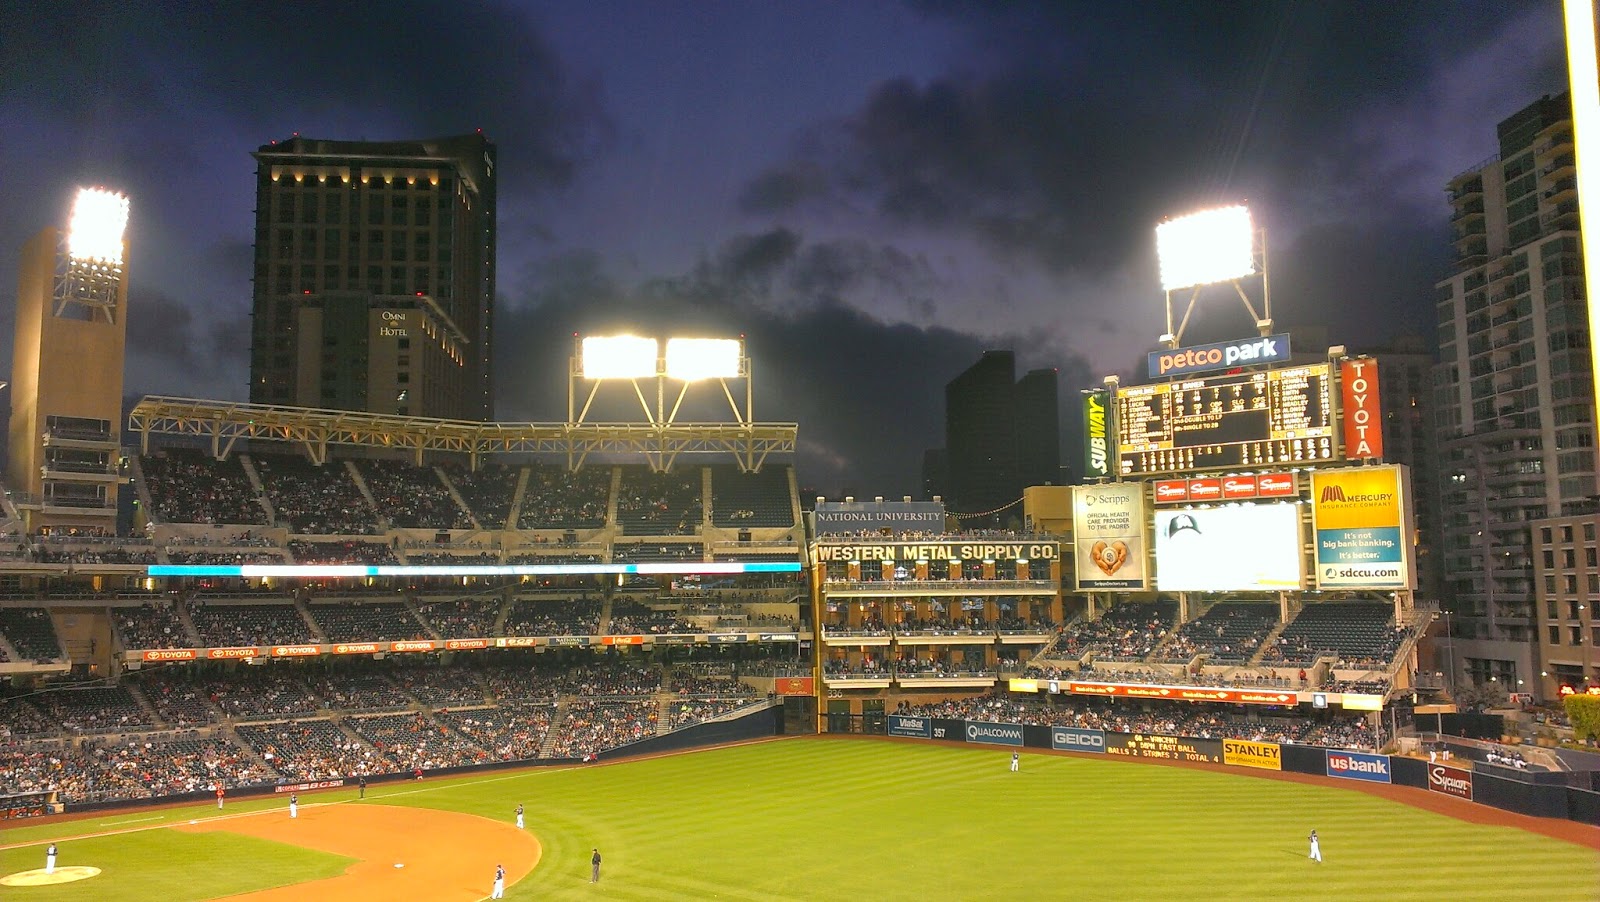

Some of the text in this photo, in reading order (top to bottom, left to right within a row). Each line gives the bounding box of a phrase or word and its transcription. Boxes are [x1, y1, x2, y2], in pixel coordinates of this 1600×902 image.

[382, 311, 406, 320] OMNI
[380, 327, 407, 336] HOTEL
[1160, 338, 1278, 374] petco park
[1352, 363, 1372, 454] TOYOTA
[1088, 394, 1108, 474] SUBWAY
[1098, 494, 1130, 505] Scripps
[1348, 494, 1392, 502] MERCURY
[818, 511, 940, 522] NATIONAL UNIVERSITY
[1323, 539, 1394, 549] big bank banking.
[818, 545, 1058, 562] WESTERN METAL SUPPLY CO.
[1340, 568, 1398, 578] sdccu.com
[160, 650, 192, 658] TOYOTA
[828, 690, 842, 698] 336
[899, 718, 924, 728] ViaSat
[934, 728, 946, 738] 357
[968, 724, 1020, 740] QUALCOMM
[1054, 732, 1103, 747] GEICO
[1108, 746, 1130, 755] BALLS
[1142, 750, 1170, 758] STRIKES
[1186, 754, 1209, 762] TOTAL
[1159, 744, 1176, 752] FAST
[1178, 745, 1196, 754] BALL
[1225, 744, 1279, 758] STANLEY
[1432, 767, 1468, 790] Sycuan
